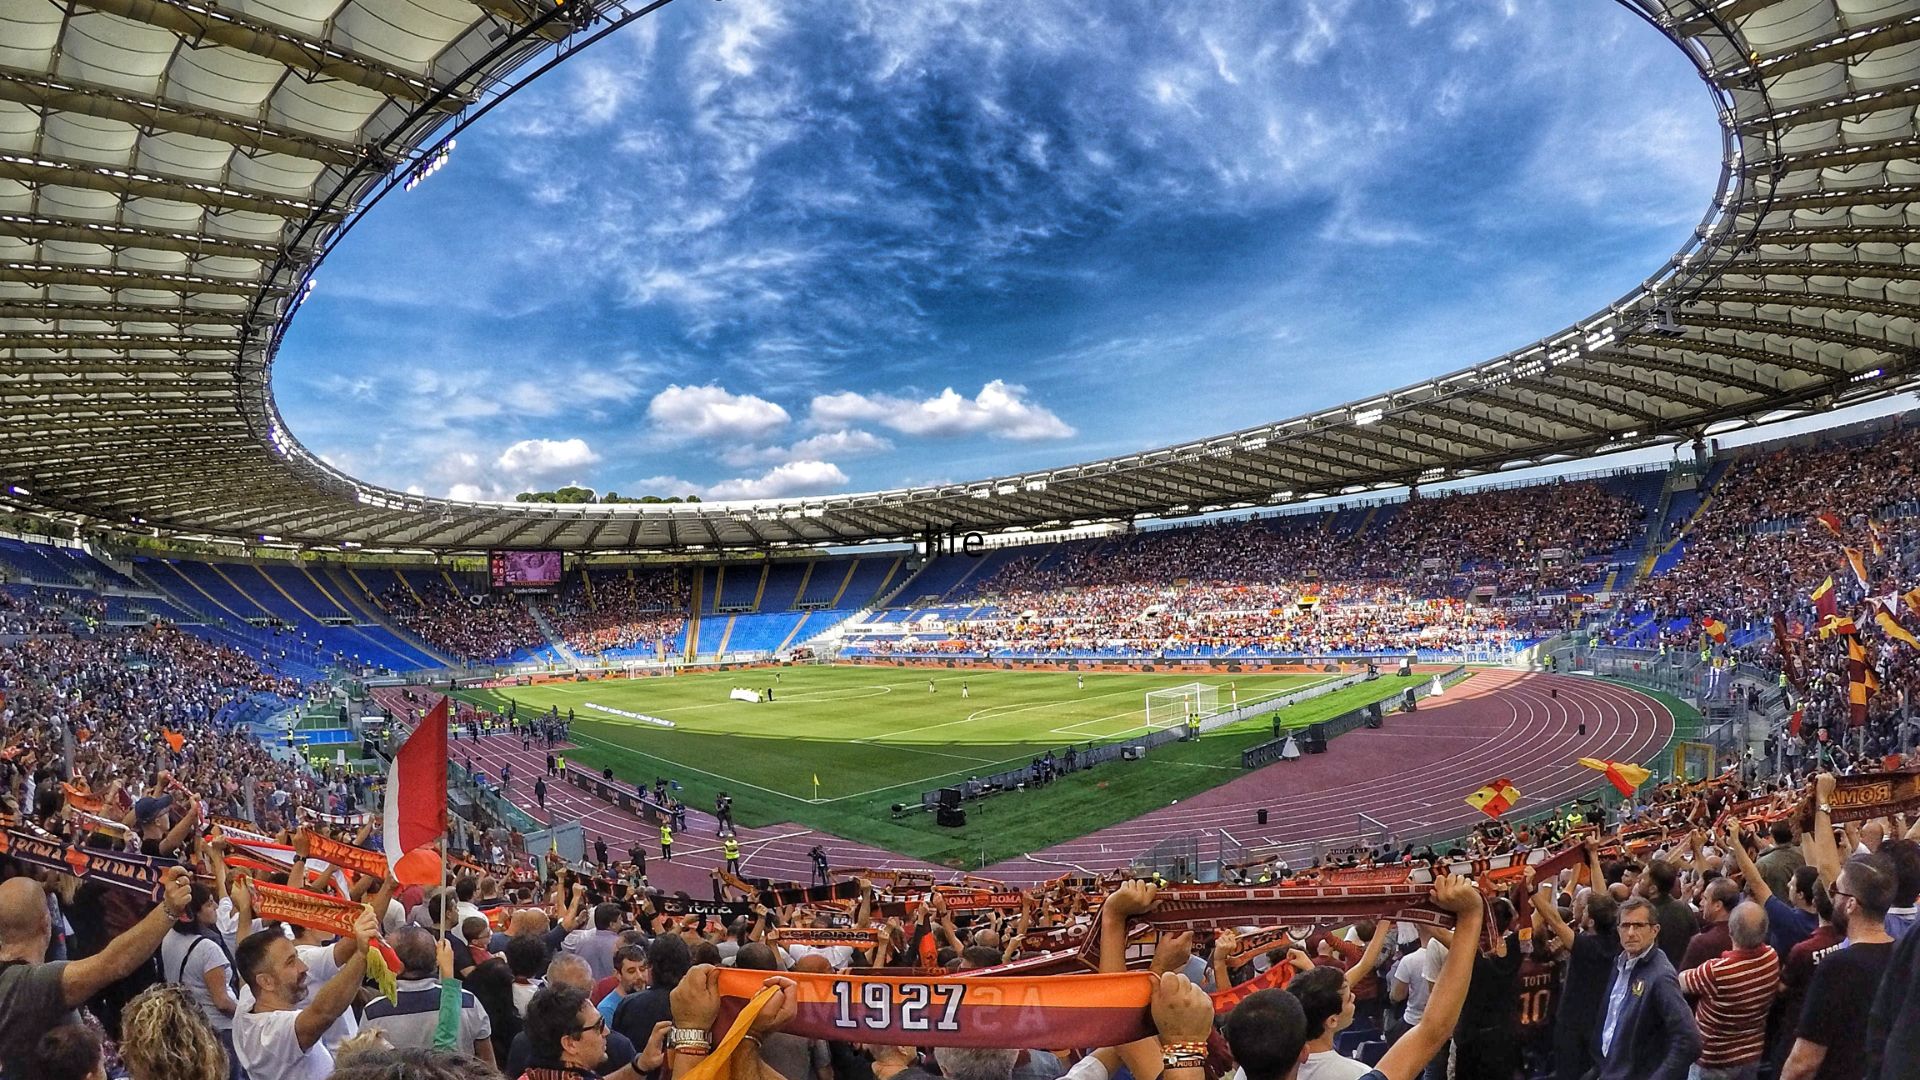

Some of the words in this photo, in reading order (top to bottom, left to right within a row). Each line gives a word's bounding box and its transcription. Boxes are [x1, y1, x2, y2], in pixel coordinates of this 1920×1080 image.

[528, 587, 548, 595] Olimpico
[92, 857, 148, 881] ROMA
[990, 895, 1022, 904] ROMA
[833, 980, 966, 1031] 1927
[1520, 989, 1551, 1025] 10
